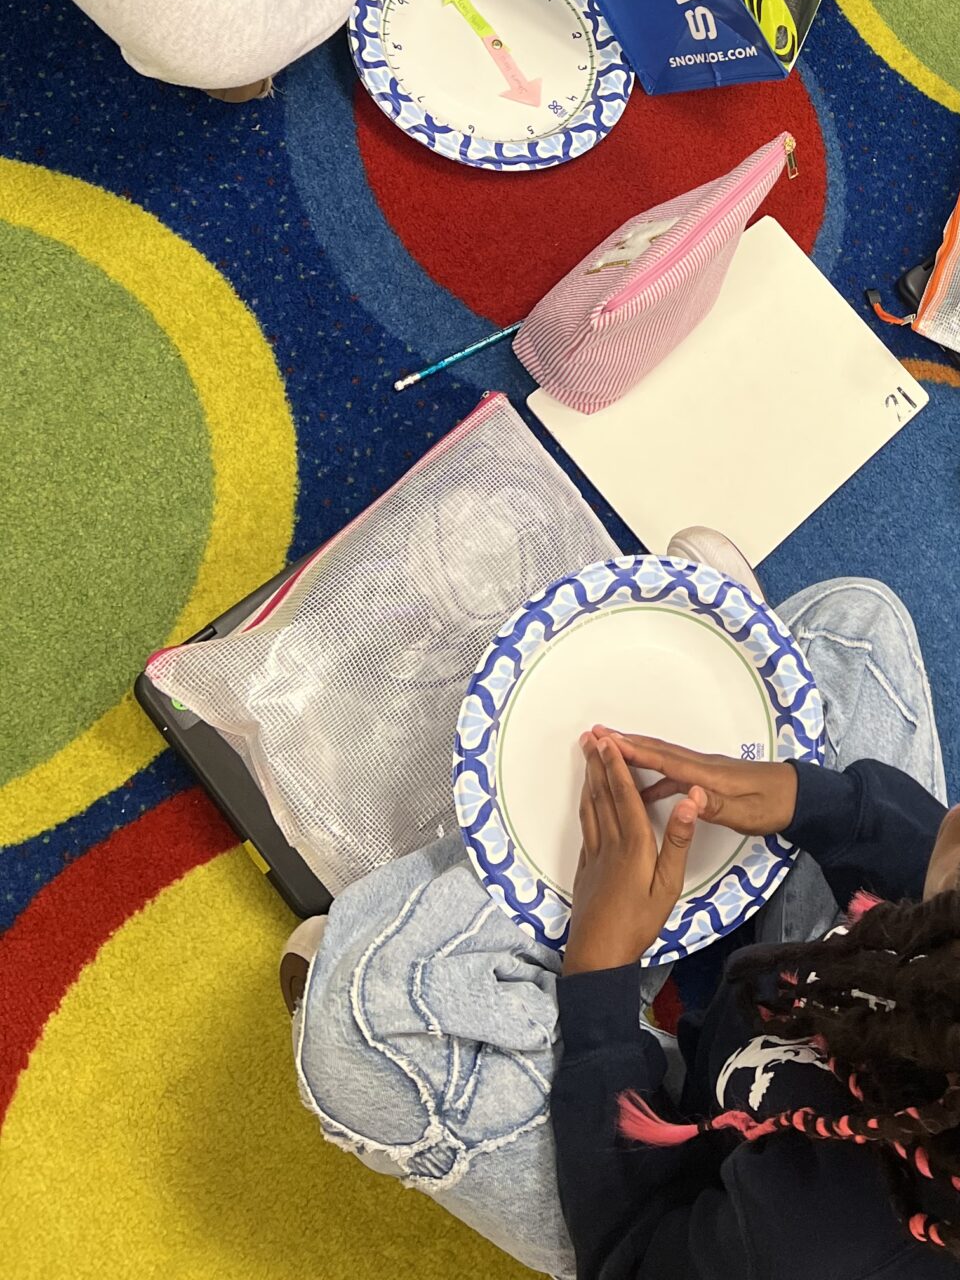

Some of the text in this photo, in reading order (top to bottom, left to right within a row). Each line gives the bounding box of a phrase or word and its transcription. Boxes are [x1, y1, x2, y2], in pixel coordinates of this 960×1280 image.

[571, 32, 583, 40] 2
[391, 42, 403, 51] 8
[669, 46, 758, 68] SNOWJOE.COM
[577, 64, 589, 72] 3
[416, 94, 426, 104] 7
[566, 94, 578, 103] 4
[467, 123, 477, 135] 6
[525, 124, 535, 136] 5
